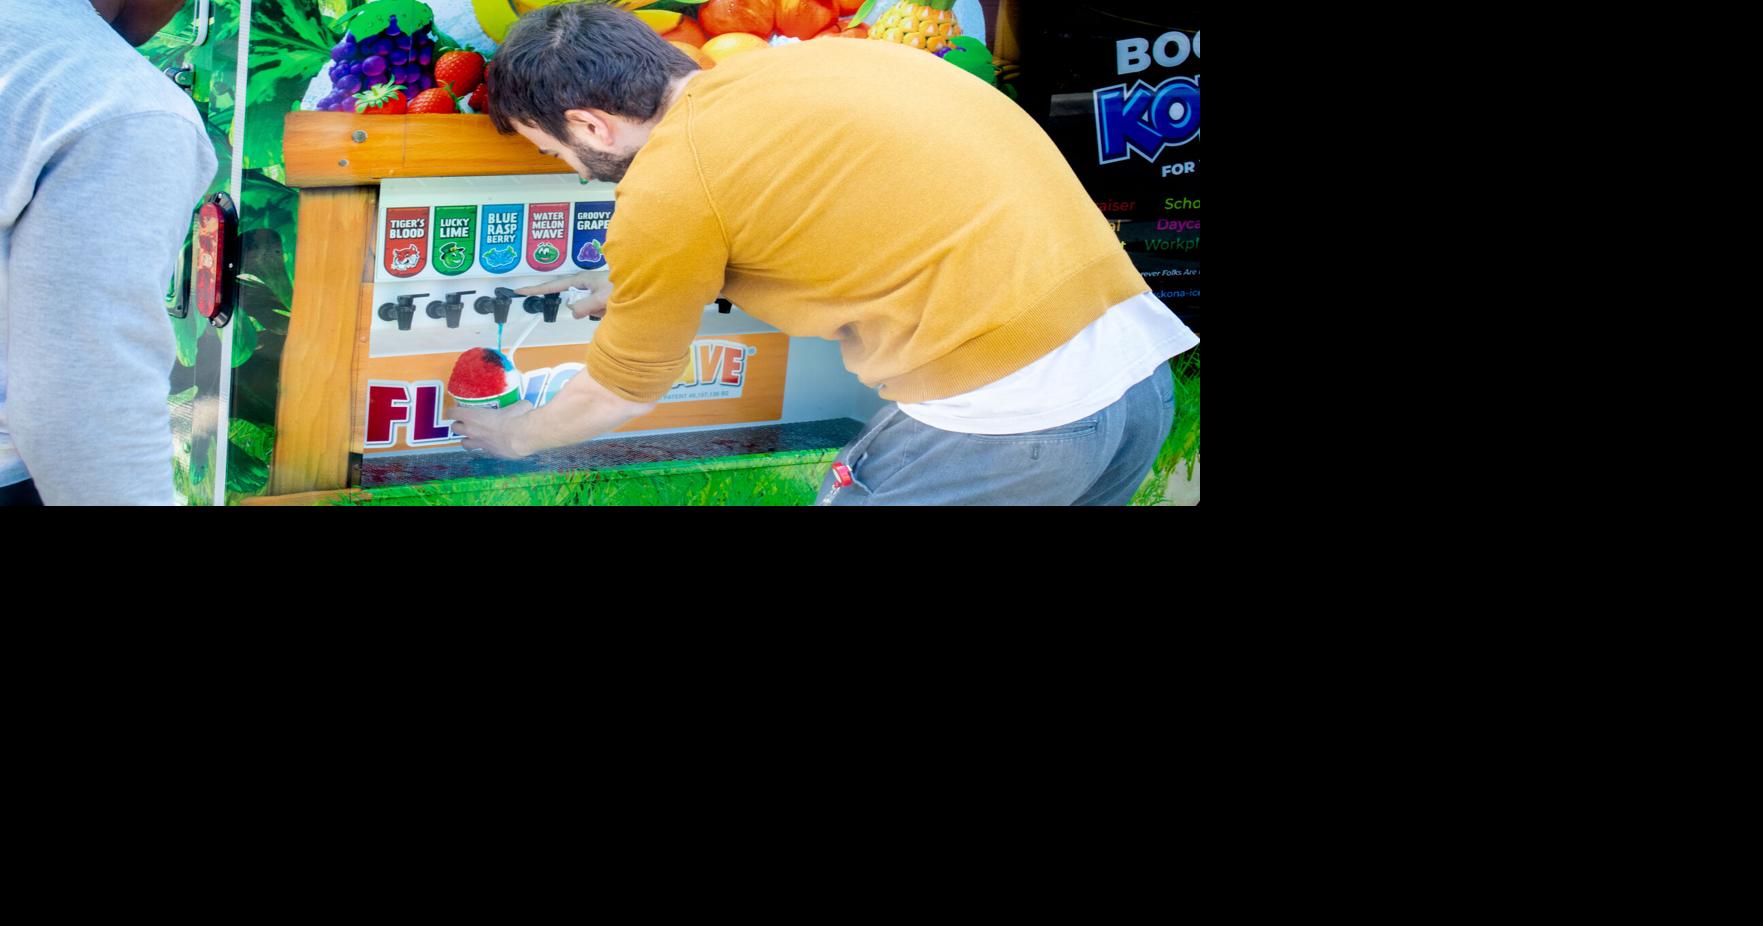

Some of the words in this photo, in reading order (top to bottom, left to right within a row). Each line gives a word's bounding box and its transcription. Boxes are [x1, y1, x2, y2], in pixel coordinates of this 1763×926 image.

[1116, 30, 1200, 75] BO
[1161, 161, 1195, 177] FOR
[488, 212, 518, 224] BLUE
[533, 211, 564, 221] WATER
[577, 211, 611, 220] GROOVY
[390, 218, 425, 228] TIGER'S
[440, 218, 469, 227] LUCKY
[532, 220, 564, 229] MELON
[389, 228, 425, 239] BLOOD
[439, 227, 469, 238] LIME
[487, 223, 518, 235] RASP
[531, 229, 564, 239] WAVE
[486, 234, 516, 244] BERRY
